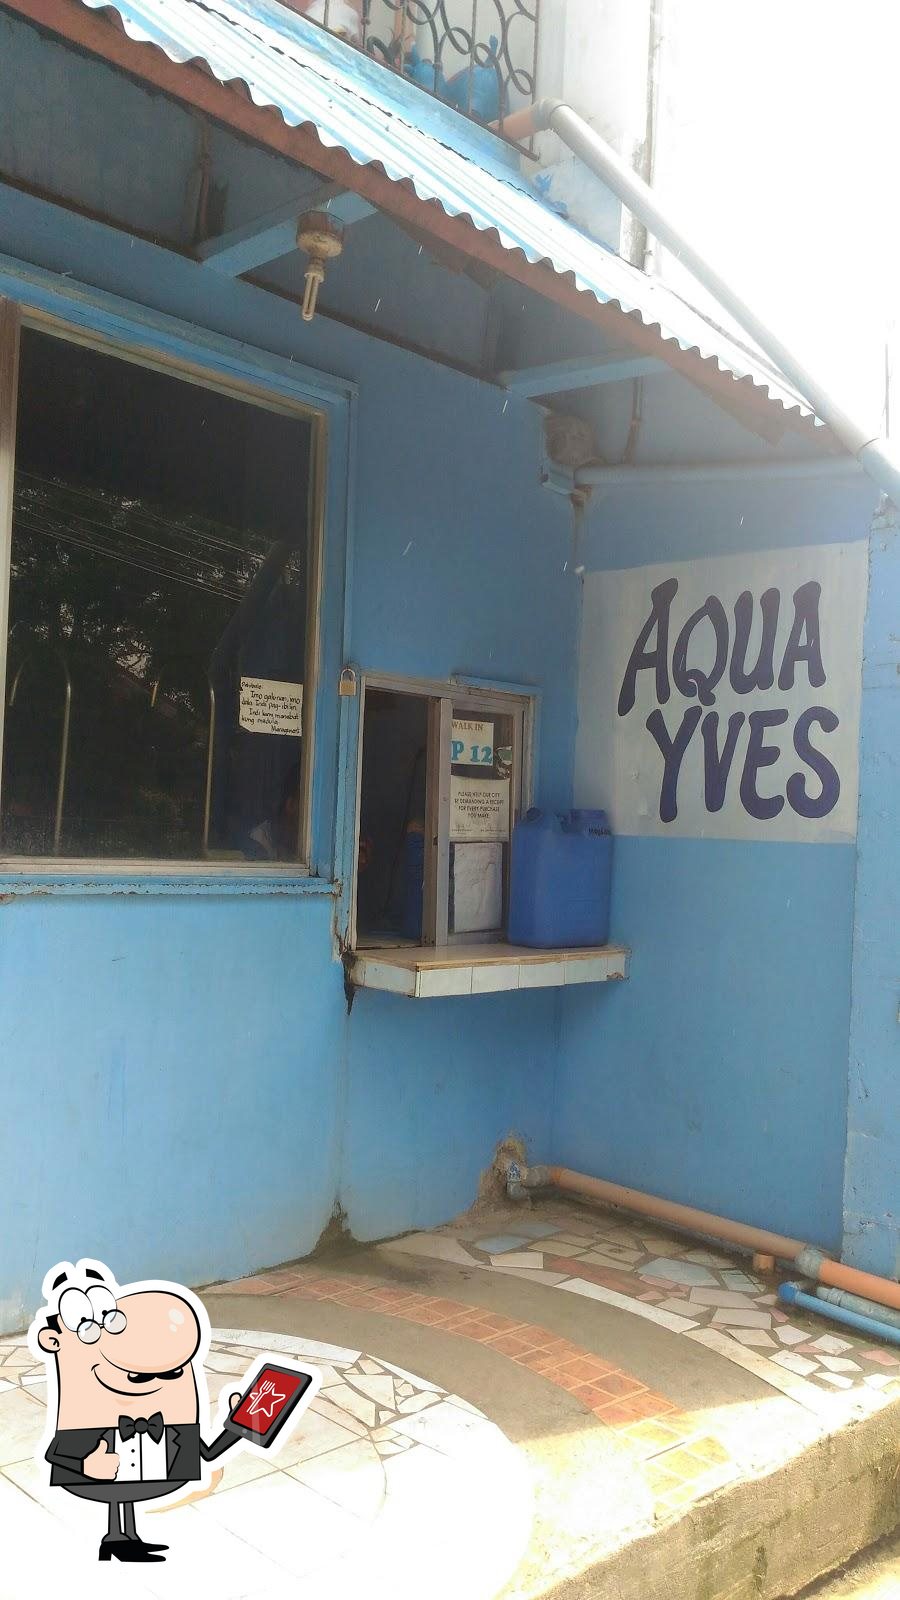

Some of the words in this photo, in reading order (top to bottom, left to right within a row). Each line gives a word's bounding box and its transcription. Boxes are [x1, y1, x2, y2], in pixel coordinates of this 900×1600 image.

[617, 577, 827, 717] AQUA
[250, 691, 263, 700] Imo
[451, 721, 473, 730] WALK
[475, 723, 484, 731] IN
[451, 740, 464, 761] P
[470, 745, 493, 764] 12
[645, 705, 841, 824] YVES
